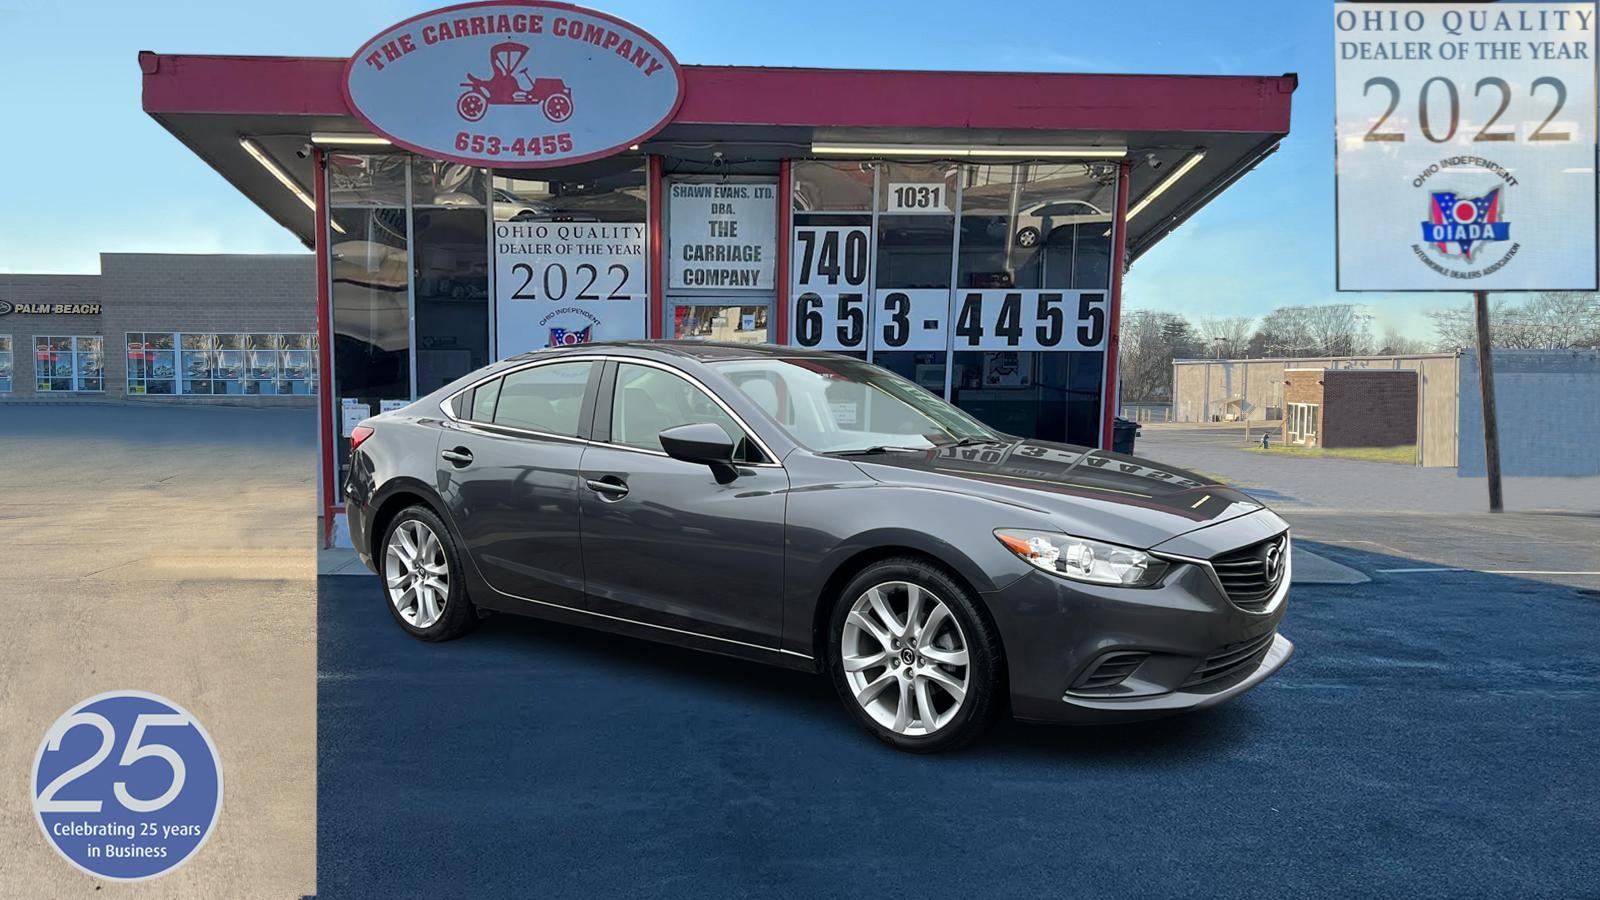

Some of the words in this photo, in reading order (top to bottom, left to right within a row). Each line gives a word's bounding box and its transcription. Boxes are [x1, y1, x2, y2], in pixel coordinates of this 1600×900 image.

[1336, 10, 1425, 32] OHIO
[1442, 10, 1594, 35] QUALITY
[366, 34, 416, 72] THE
[422, 14, 544, 46] CARRIAGE
[552, 17, 664, 77] COMPANY
[1340, 42, 1433, 60] DEALER
[1439, 42, 1469, 60] OF
[1475, 42, 1522, 60] THE
[1528, 42, 1589, 60] YEAR
[1363, 76, 1571, 143] 2022
[455, 132, 573, 156] 653-4455
[1413, 164, 1440, 188] OHIO
[1440, 156, 1519, 187] INDEPENDENT
[672, 186, 712, 199] SHAWN
[754, 187, 775, 199] LTD.
[894, 187, 940, 208] 1031
[711, 203, 736, 215] DBA.
[496, 226, 549, 239] OHIO
[557, 226, 645, 240] QUALITY
[708, 220, 738, 238] THE
[1433, 224, 1495, 240] OIADA
[499, 244, 552, 255] DEALER
[555, 244, 574, 255] OF
[575, 244, 603, 255] THE
[605, 244, 641, 255] YEAR
[683, 245, 762, 262] CARRIAGE
[797, 230, 867, 286] 740
[1411, 244, 1449, 277] AUTOMOBILE
[1450, 270, 1483, 280] DEALERS
[1483, 242, 1520, 276] ASSOCIATION
[511, 263, 631, 301] 2022
[683, 268, 760, 286] COMPANY
[15, 304, 50, 314] PALM
[54, 304, 100, 314] BEACH
